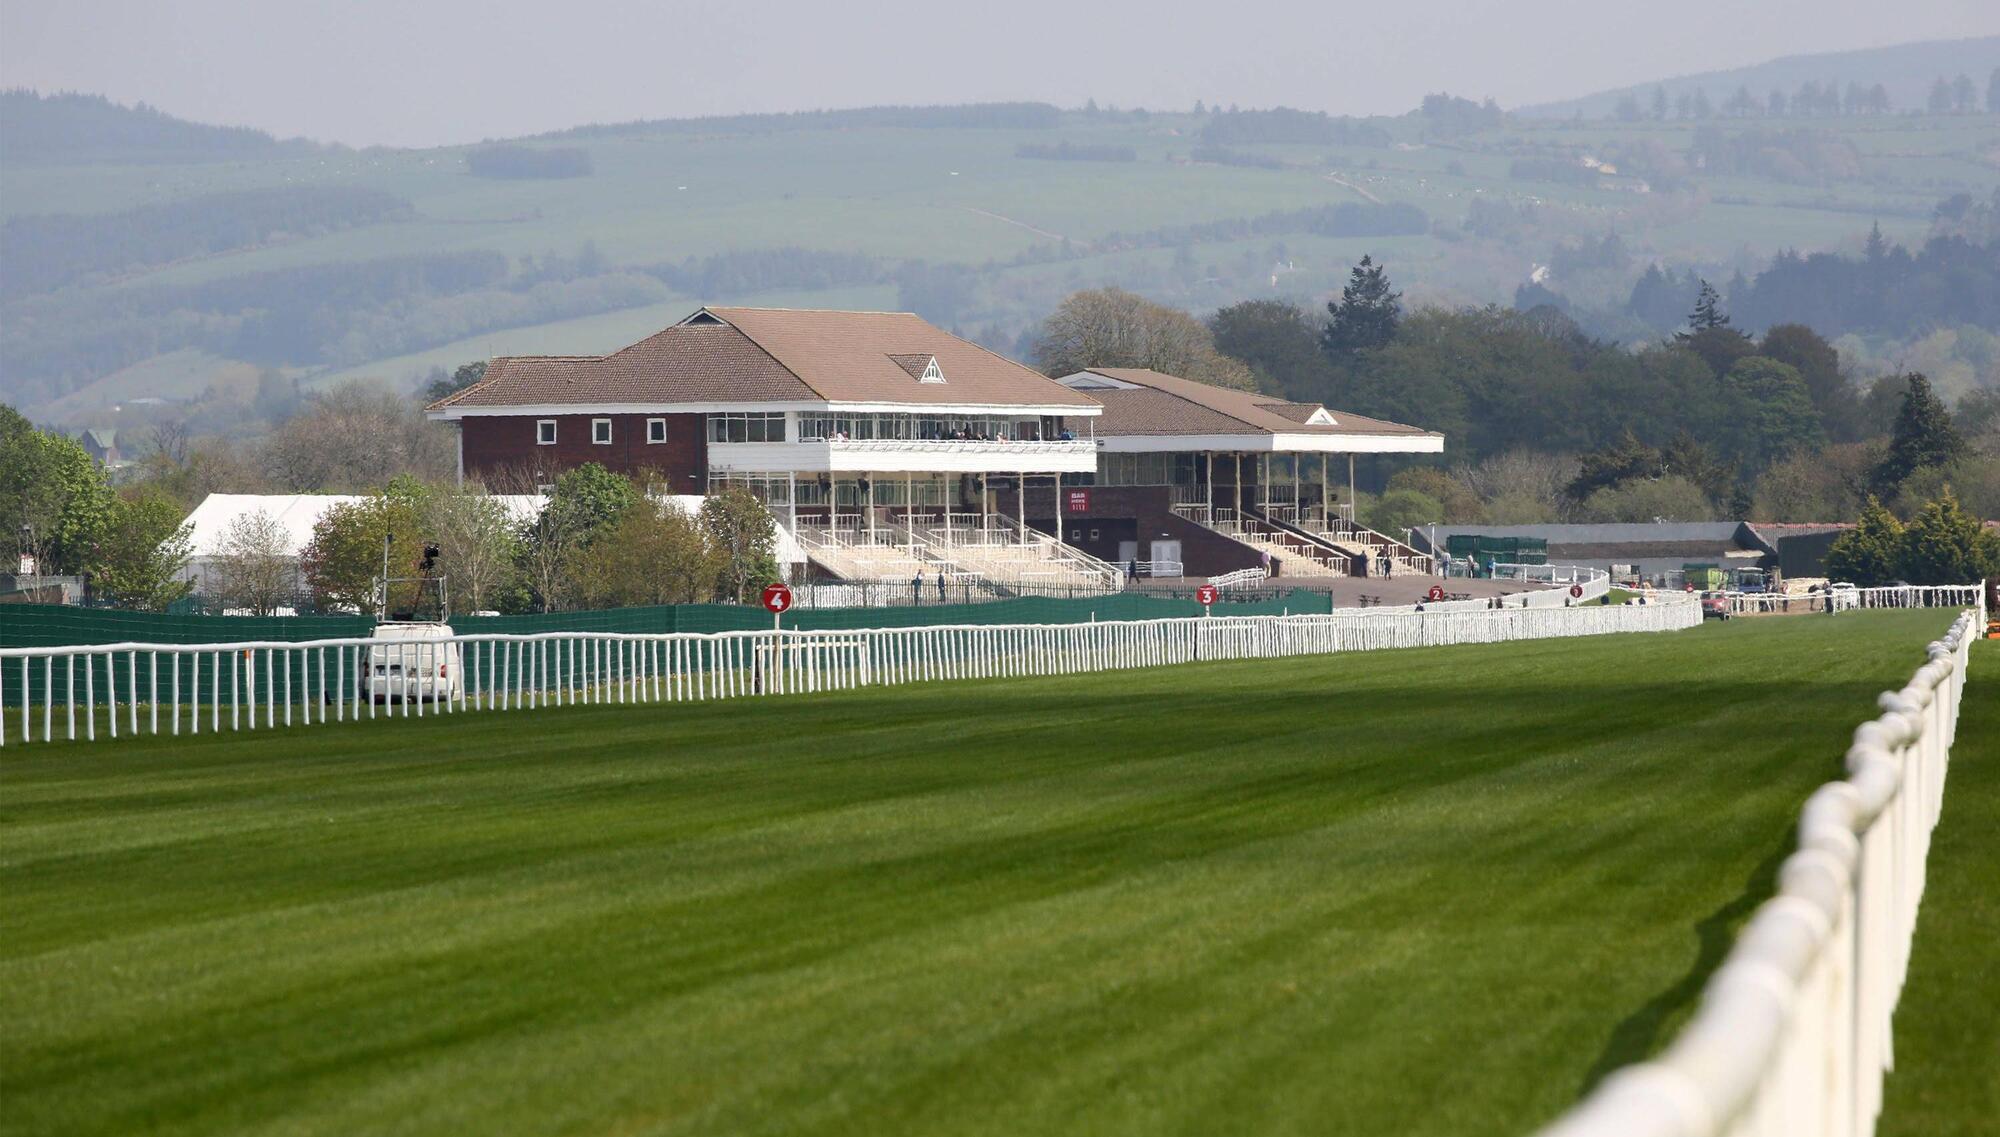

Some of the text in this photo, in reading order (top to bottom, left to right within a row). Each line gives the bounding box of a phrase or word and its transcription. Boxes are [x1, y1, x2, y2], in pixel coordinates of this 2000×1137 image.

[771, 592, 784, 609] 4
[1203, 590, 1211, 603] 3
[1433, 590, 1441, 600] 2
